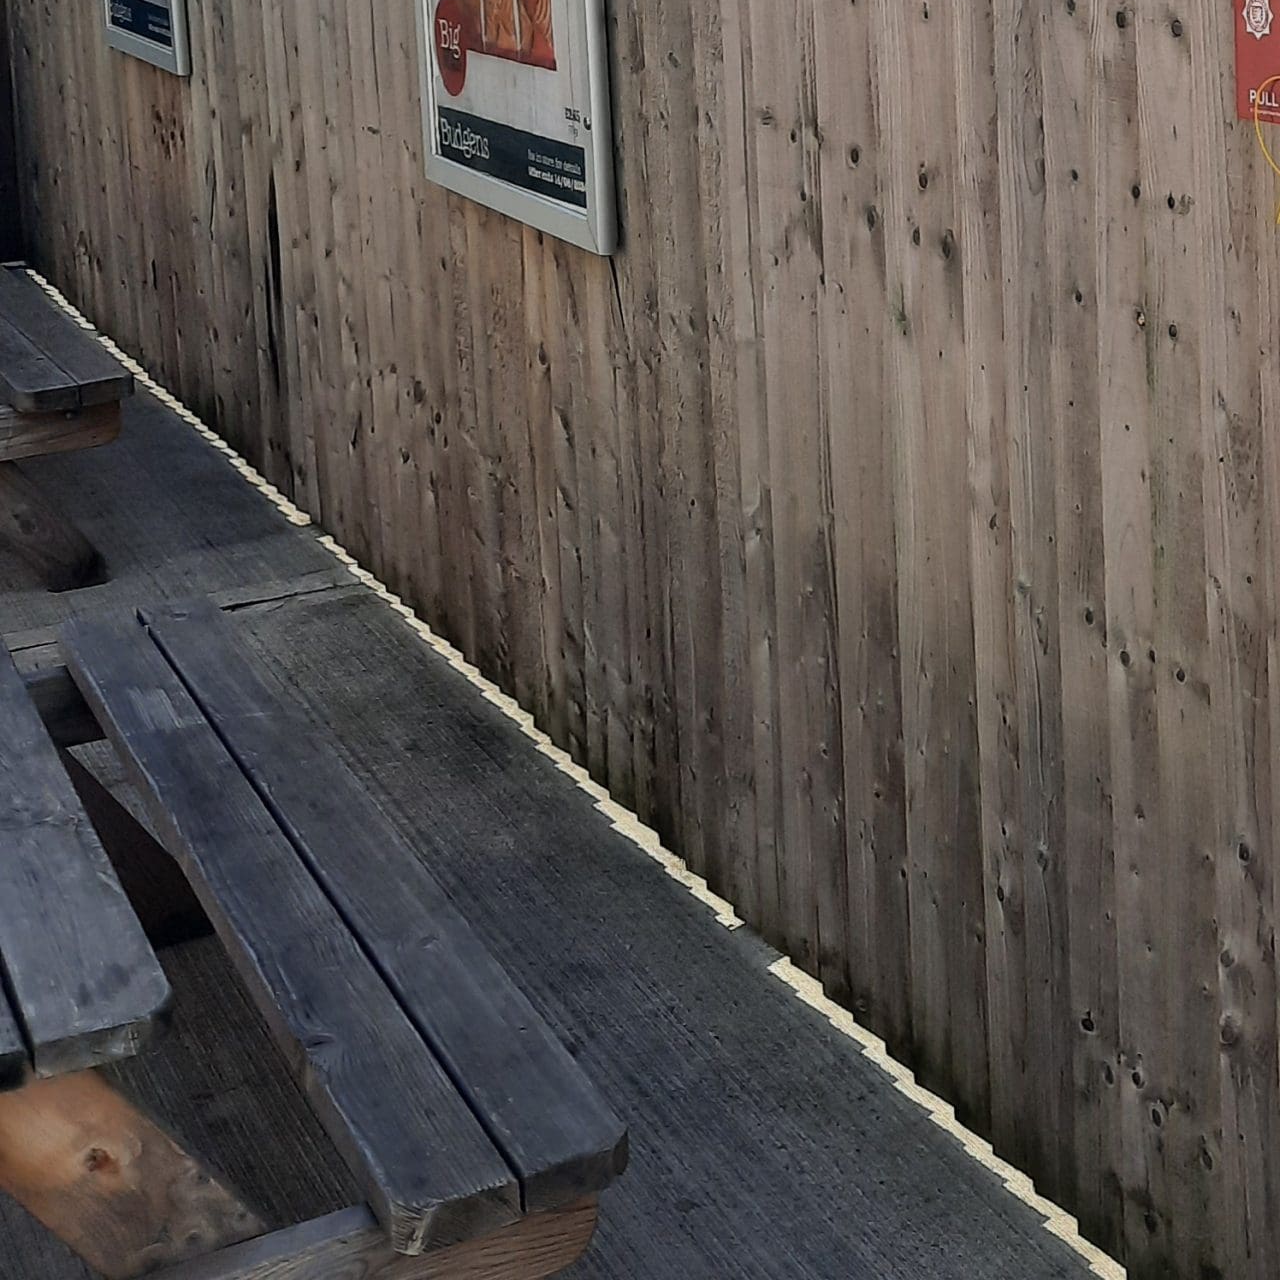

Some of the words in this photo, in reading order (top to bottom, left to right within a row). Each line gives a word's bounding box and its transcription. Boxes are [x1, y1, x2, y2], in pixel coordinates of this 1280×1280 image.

[438, 19, 462, 59] Big
[1249, 89, 1279, 108] PULL
[440, 117, 491, 160] Budgens
